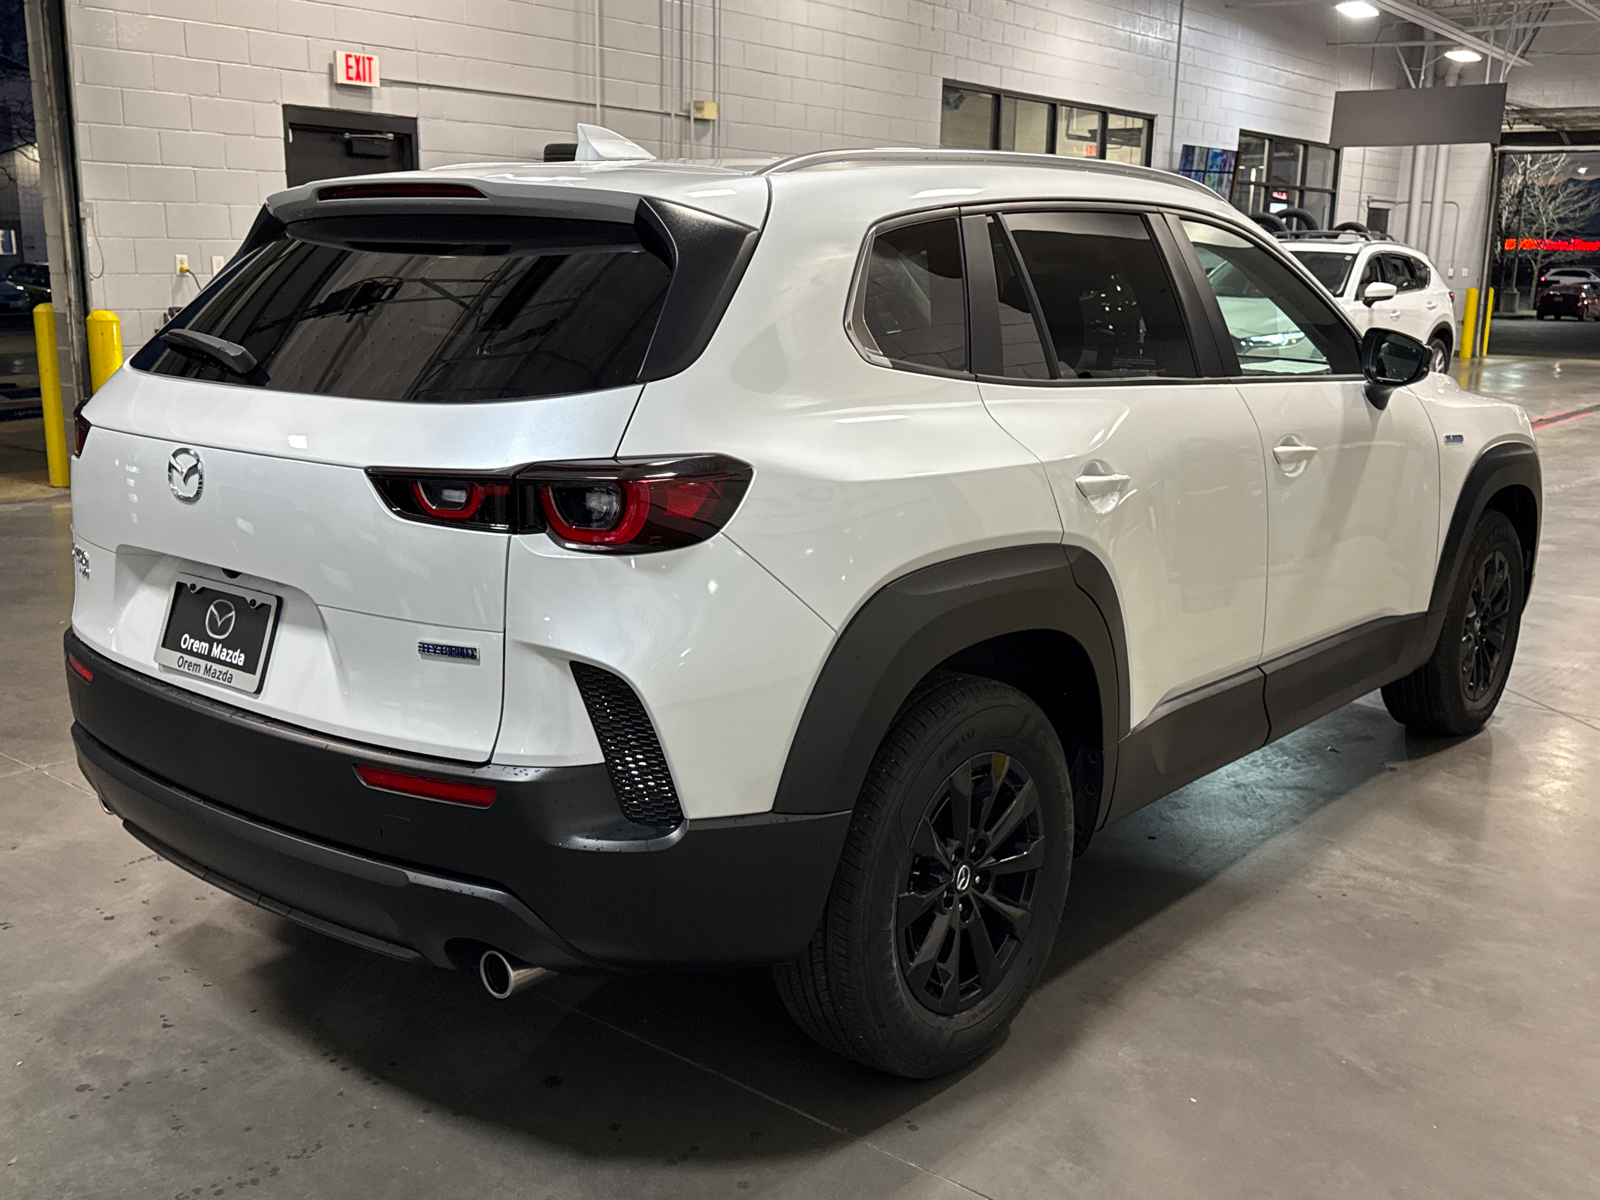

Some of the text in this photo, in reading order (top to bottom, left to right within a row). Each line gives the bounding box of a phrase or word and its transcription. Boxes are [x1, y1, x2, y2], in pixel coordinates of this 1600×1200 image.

[345, 53, 373, 83] EXIT
[180, 633, 245, 666] Orem Mazda
[420, 642, 476, 659] HYBRID
[177, 655, 233, 683] Orem Mazda
